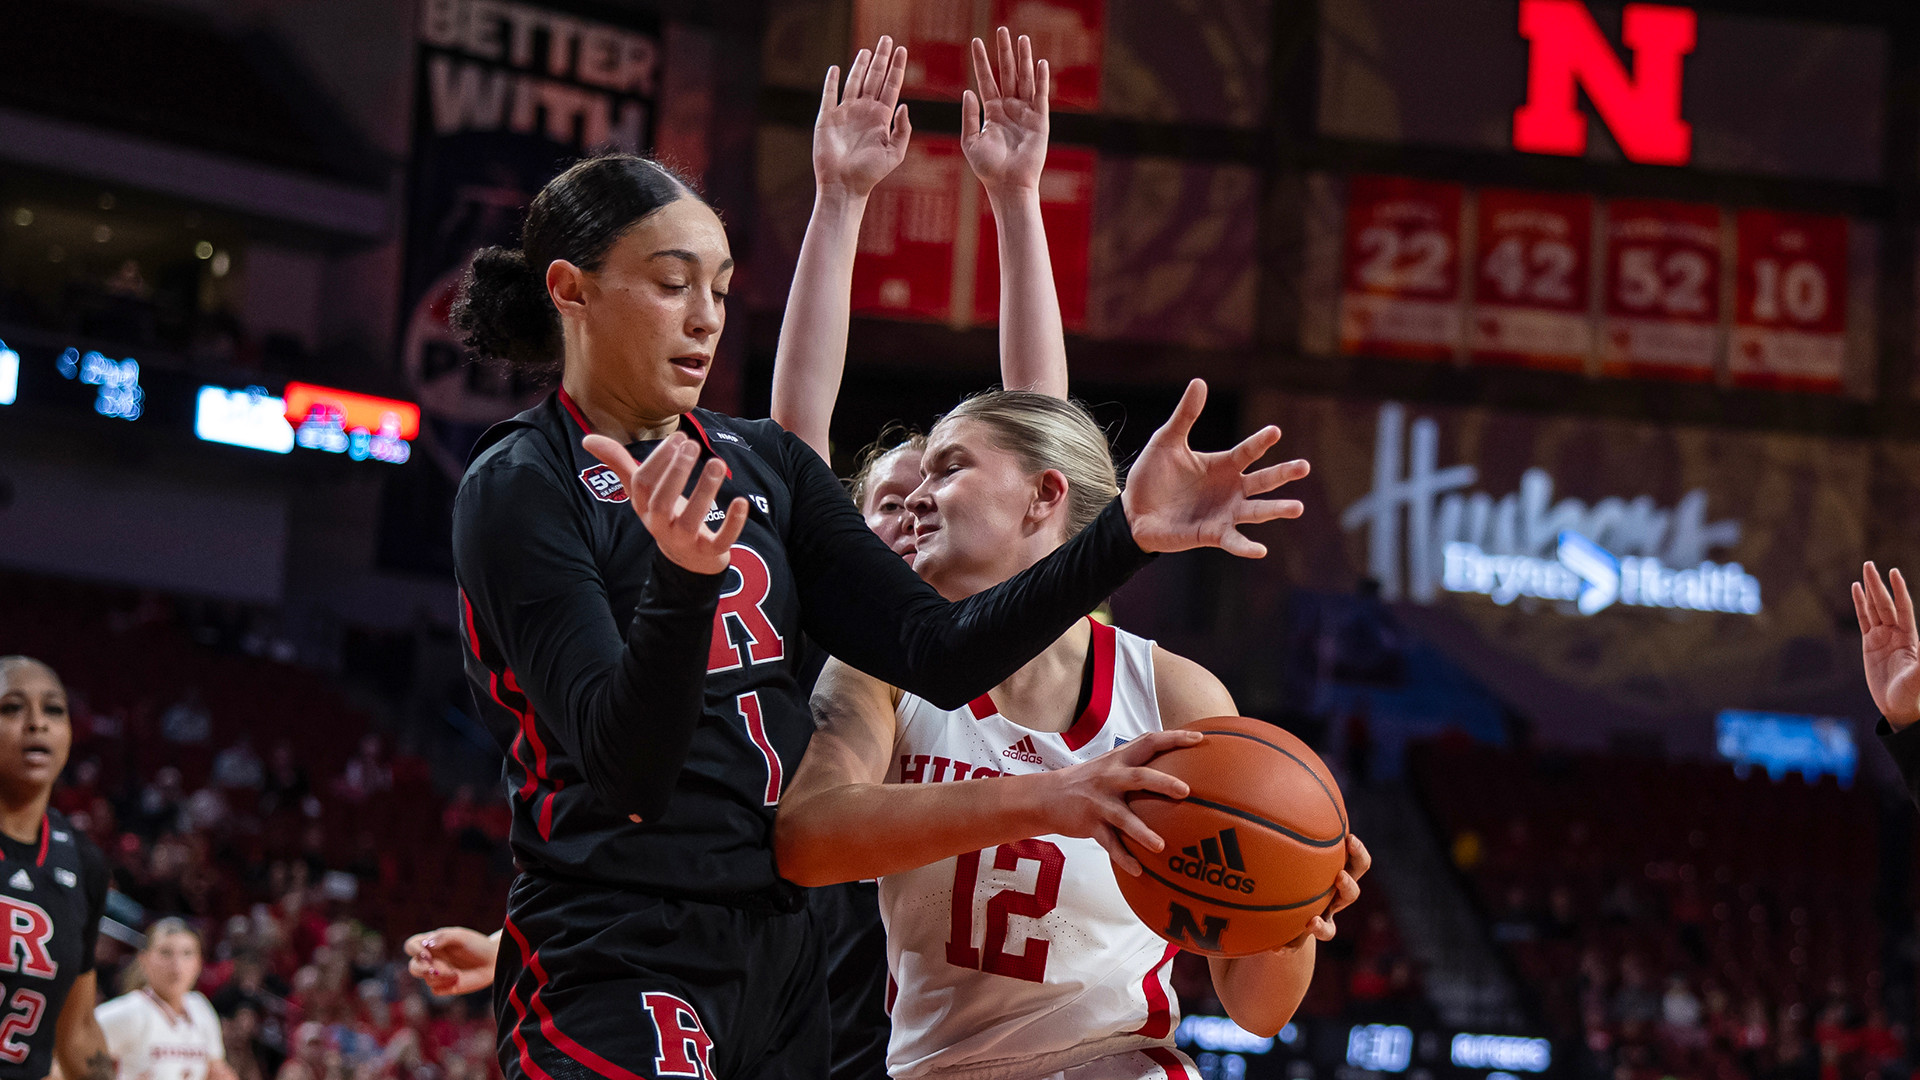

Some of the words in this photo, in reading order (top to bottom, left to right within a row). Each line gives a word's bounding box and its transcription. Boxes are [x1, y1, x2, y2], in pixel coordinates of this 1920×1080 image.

[421, 0, 655, 96] BETTER
[1513, 0, 1698, 166] N
[429, 56, 646, 154] WITH
[1359, 228, 1451, 290] 22
[1484, 238, 1577, 300] 42
[1619, 250, 1710, 314] 52
[1752, 258, 1829, 324] 10
[588, 470, 621, 491] 50
[706, 543, 785, 675] R
[736, 690, 783, 807] 1
[1002, 748, 1044, 765] adidas
[945, 838, 1066, 984] 12
[1167, 854, 1257, 896] adidas
[0, 893, 59, 981] R
[1165, 901, 1232, 951] N
[640, 991, 719, 1080] R
